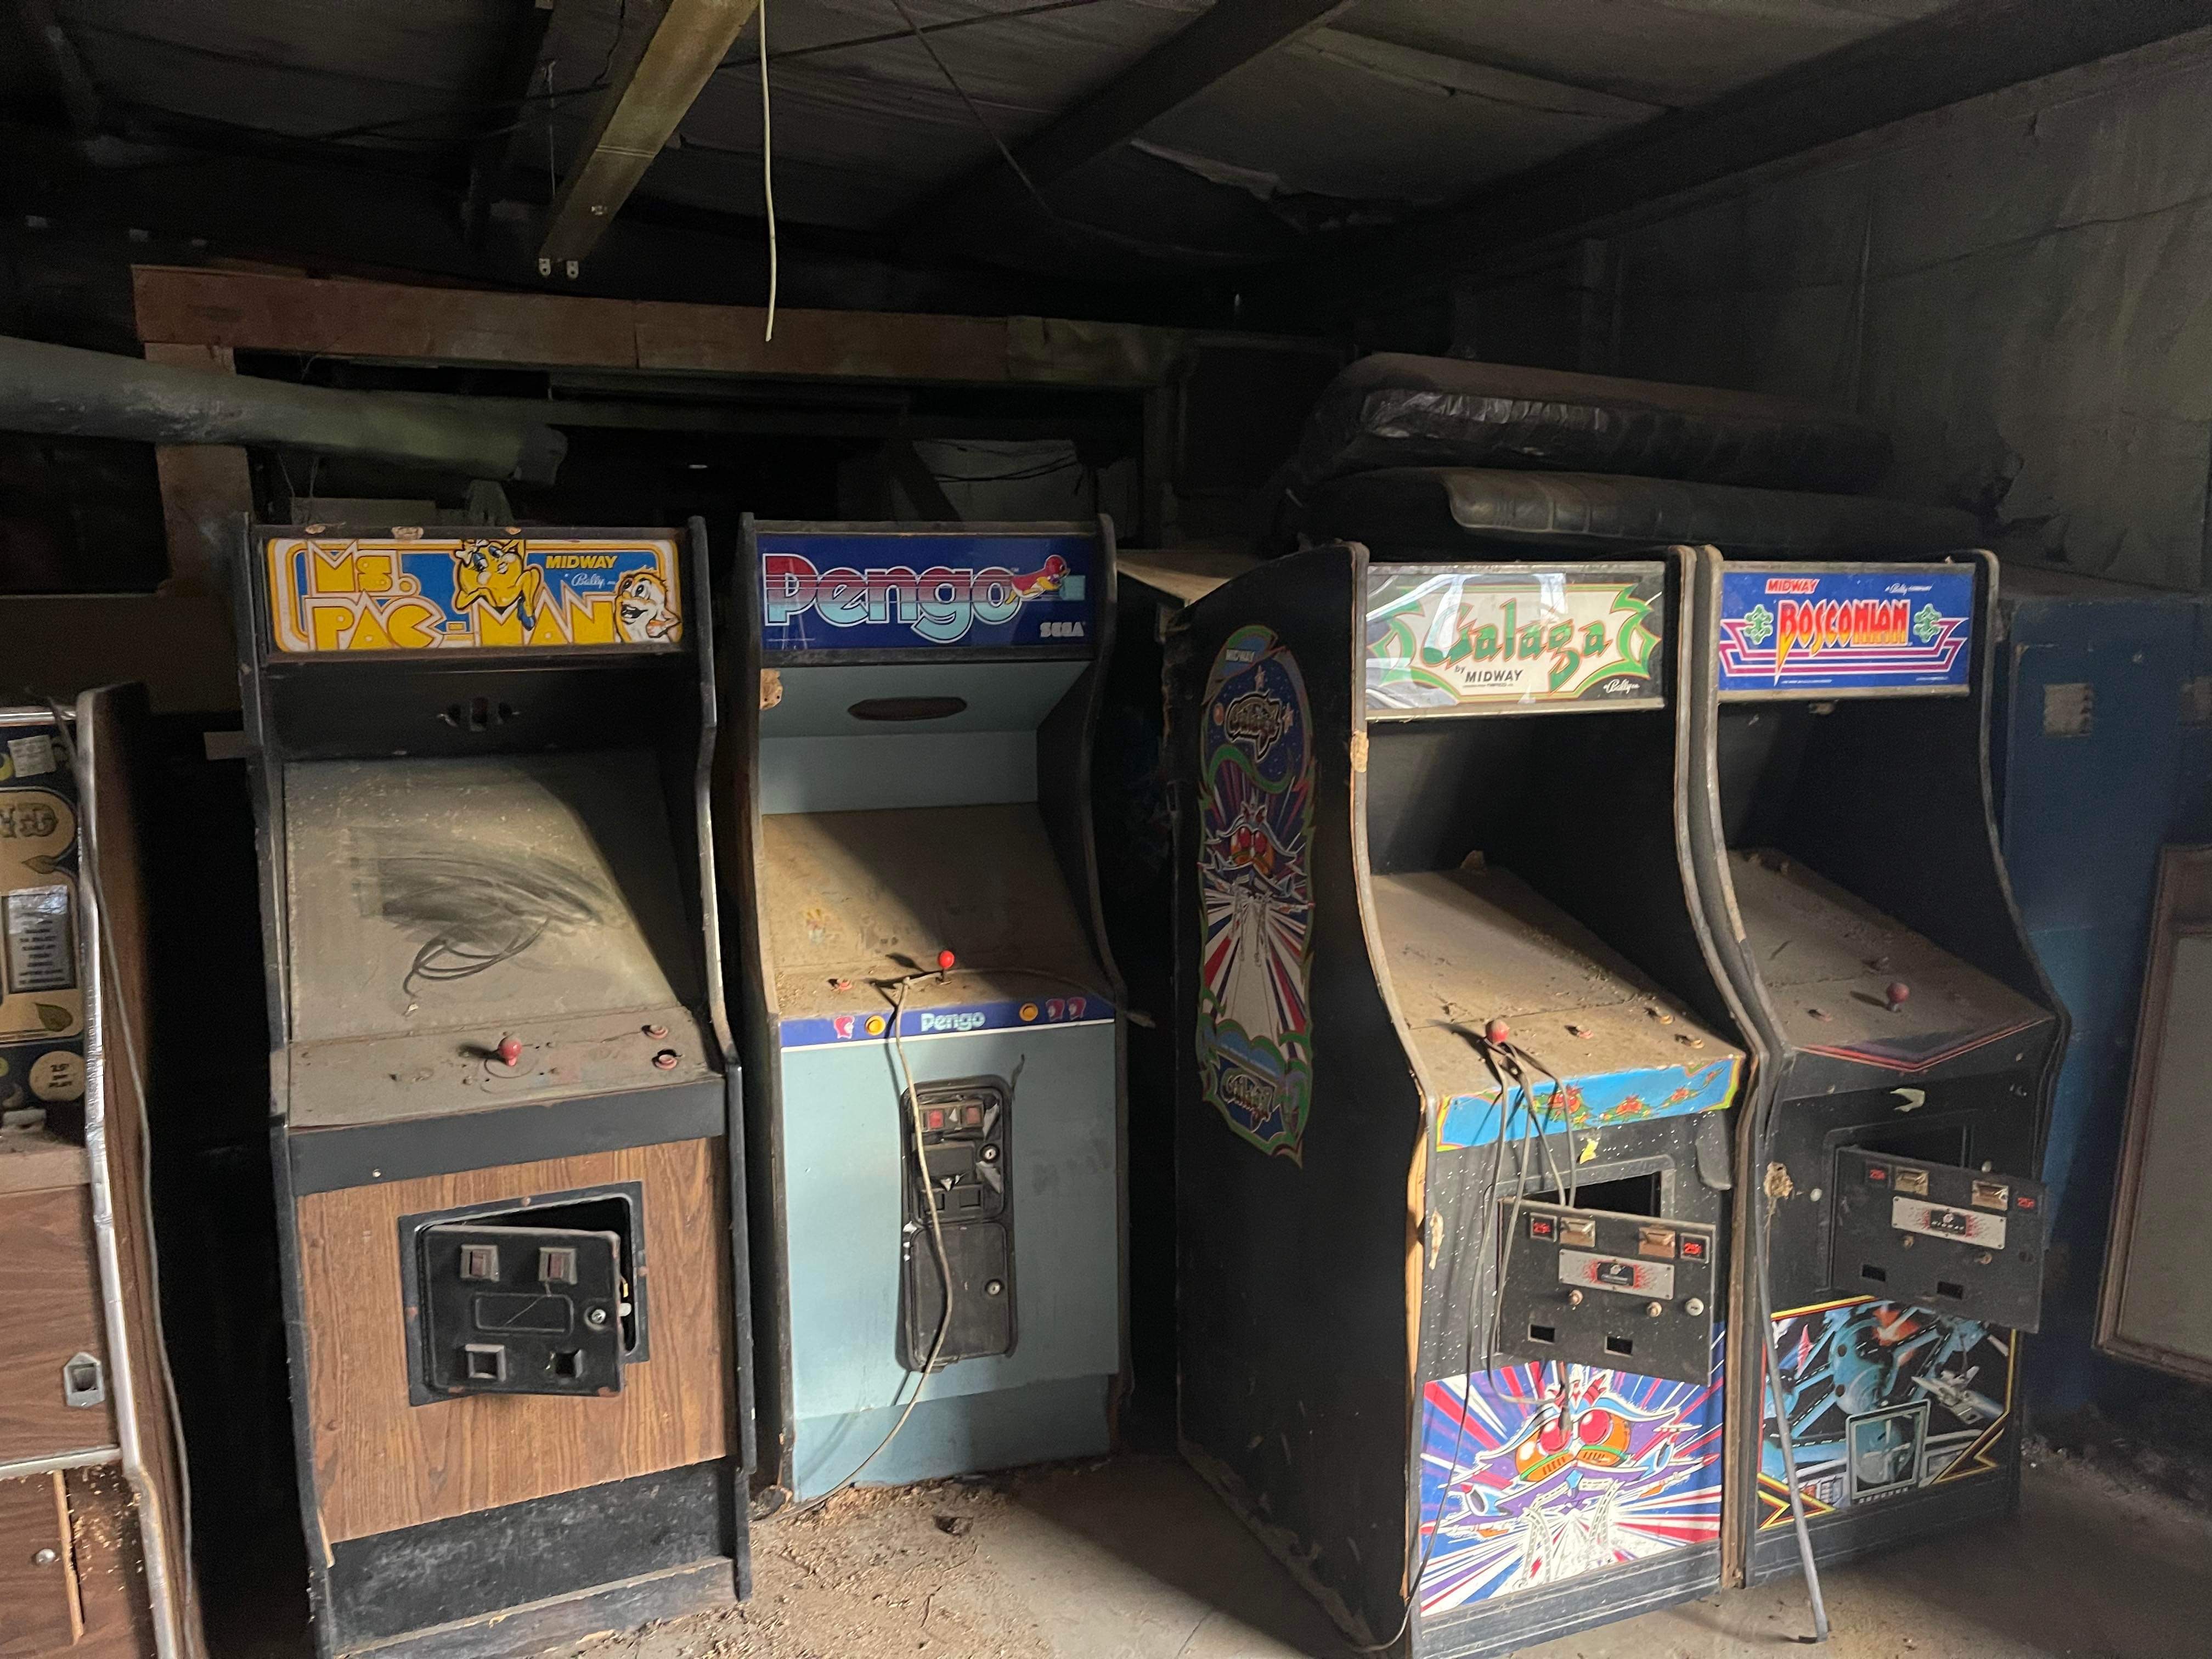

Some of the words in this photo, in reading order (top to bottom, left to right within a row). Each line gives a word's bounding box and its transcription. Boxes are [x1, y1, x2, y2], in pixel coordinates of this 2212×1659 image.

[546, 555, 617, 569] MIDWAY
[571, 573, 605, 589] Bally
[1765, 579, 1819, 594] MIDWAY
[763, 554, 1022, 644] Pengo
[1040, 622, 1084, 637] SEGA
[1421, 597, 1613, 696] Galaga
[1774, 599, 1910, 686] BOSCONIAN
[1455, 665, 1466, 674] by
[1465, 669, 1523, 683] MIDWAY
[921, 1012, 986, 1031] Pengo
